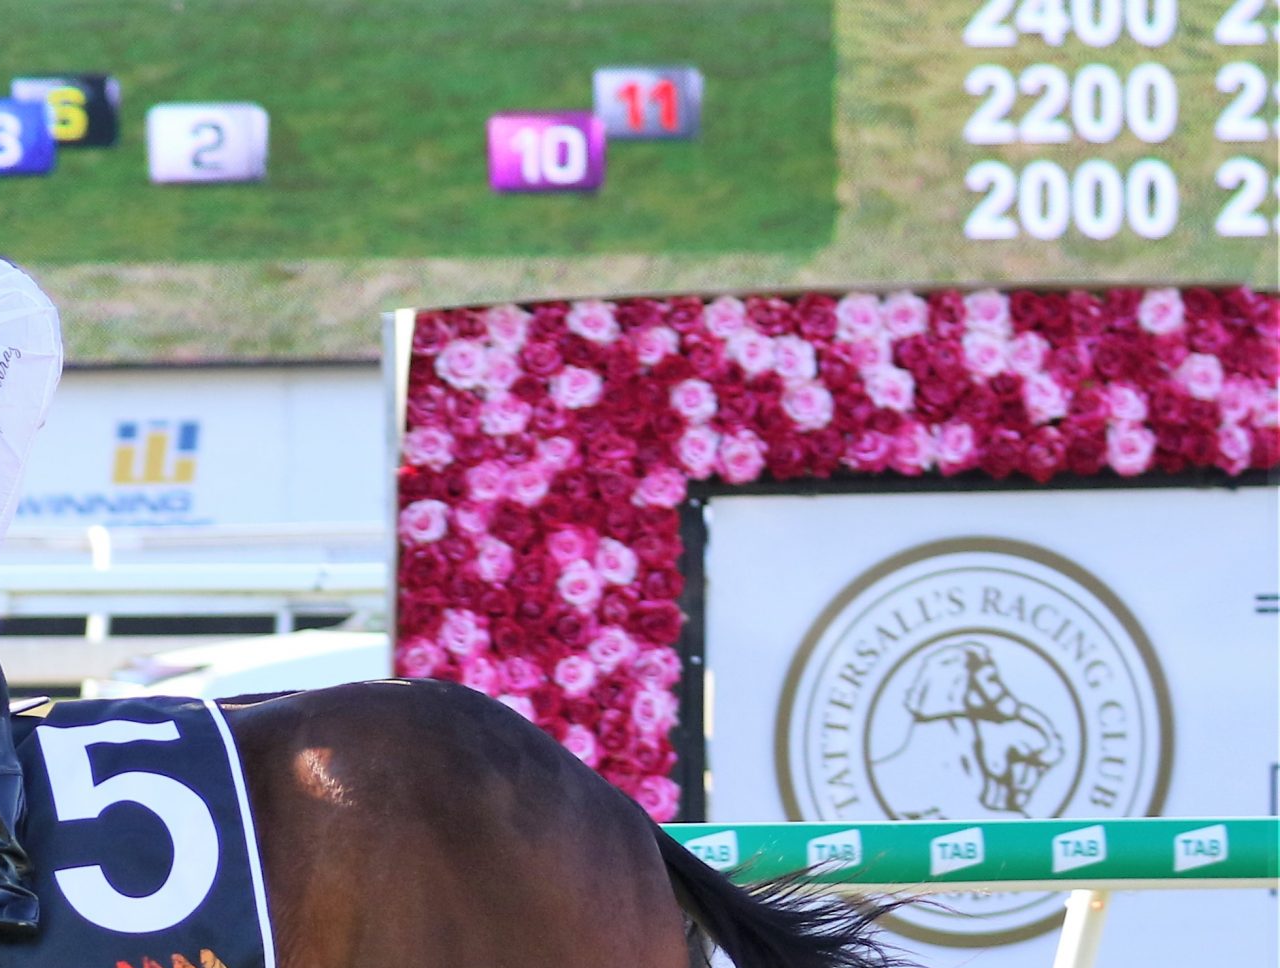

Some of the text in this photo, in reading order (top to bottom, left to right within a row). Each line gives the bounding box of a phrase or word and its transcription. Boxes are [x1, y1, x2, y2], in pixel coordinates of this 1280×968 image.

[961, 0, 1179, 48] 2400
[618, 79, 679, 133] 11
[962, 62, 1179, 145] 2200
[191, 121, 226, 170] 2
[509, 125, 588, 185] 10
[962, 158, 1179, 241] 2000
[822, 585, 1128, 819] TATTERSALL'S RACING CLUB
[36, 719, 219, 934] 5
[937, 841, 979, 860] TAB
[1058, 839, 1100, 858] TAB
[1181, 838, 1221, 857] TAB
[690, 844, 732, 862] TAB
[815, 843, 856, 861] TAB
